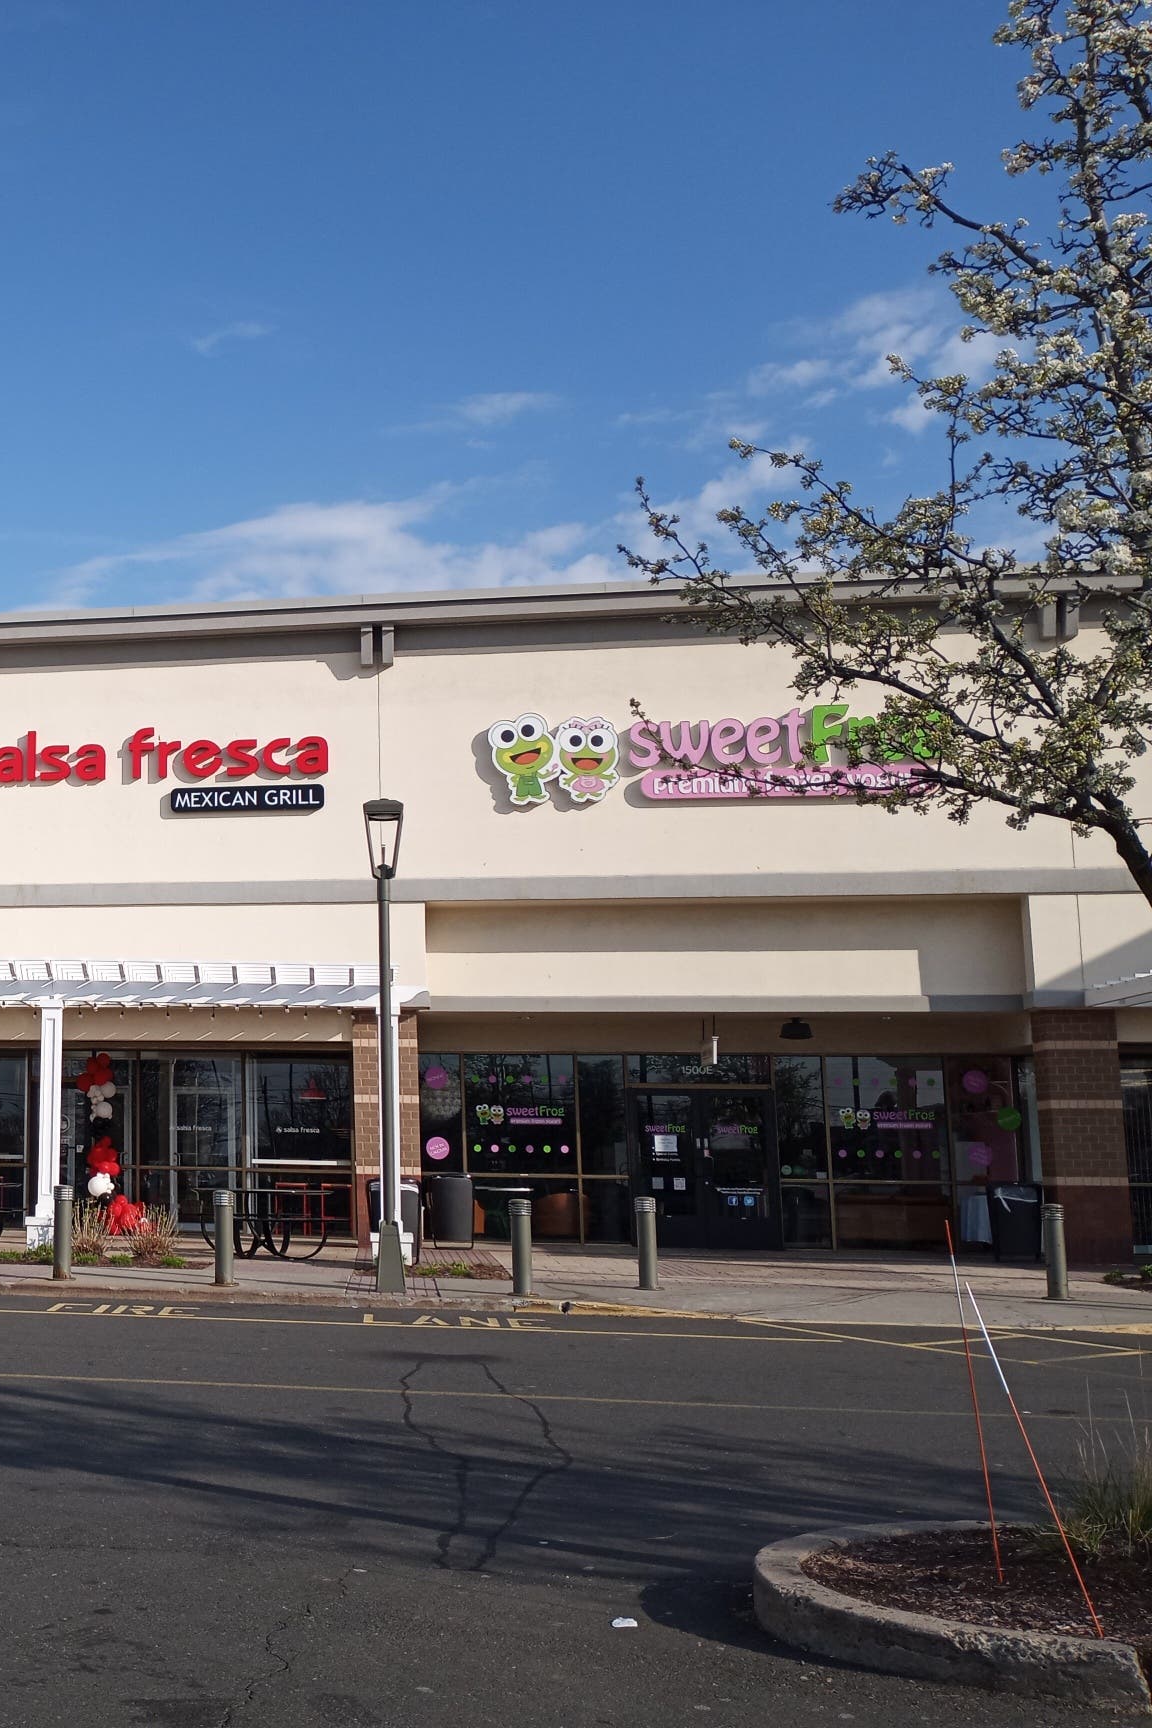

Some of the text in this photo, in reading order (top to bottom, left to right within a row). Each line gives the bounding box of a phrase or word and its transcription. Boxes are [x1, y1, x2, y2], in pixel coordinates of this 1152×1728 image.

[128, 728, 328, 779] fresca
[653, 769, 756, 795] premium
[175, 788, 320, 809] MEXICAN GRILL
[506, 1105, 565, 1117] sweetFrog
[873, 1109, 936, 1121] sweetFrog
[645, 1123, 686, 1133] sweetFrog
[717, 1124, 759, 1134] sweetFrog
[47, 1302, 202, 1317] FIRE
[363, 1313, 553, 1329] LANE
